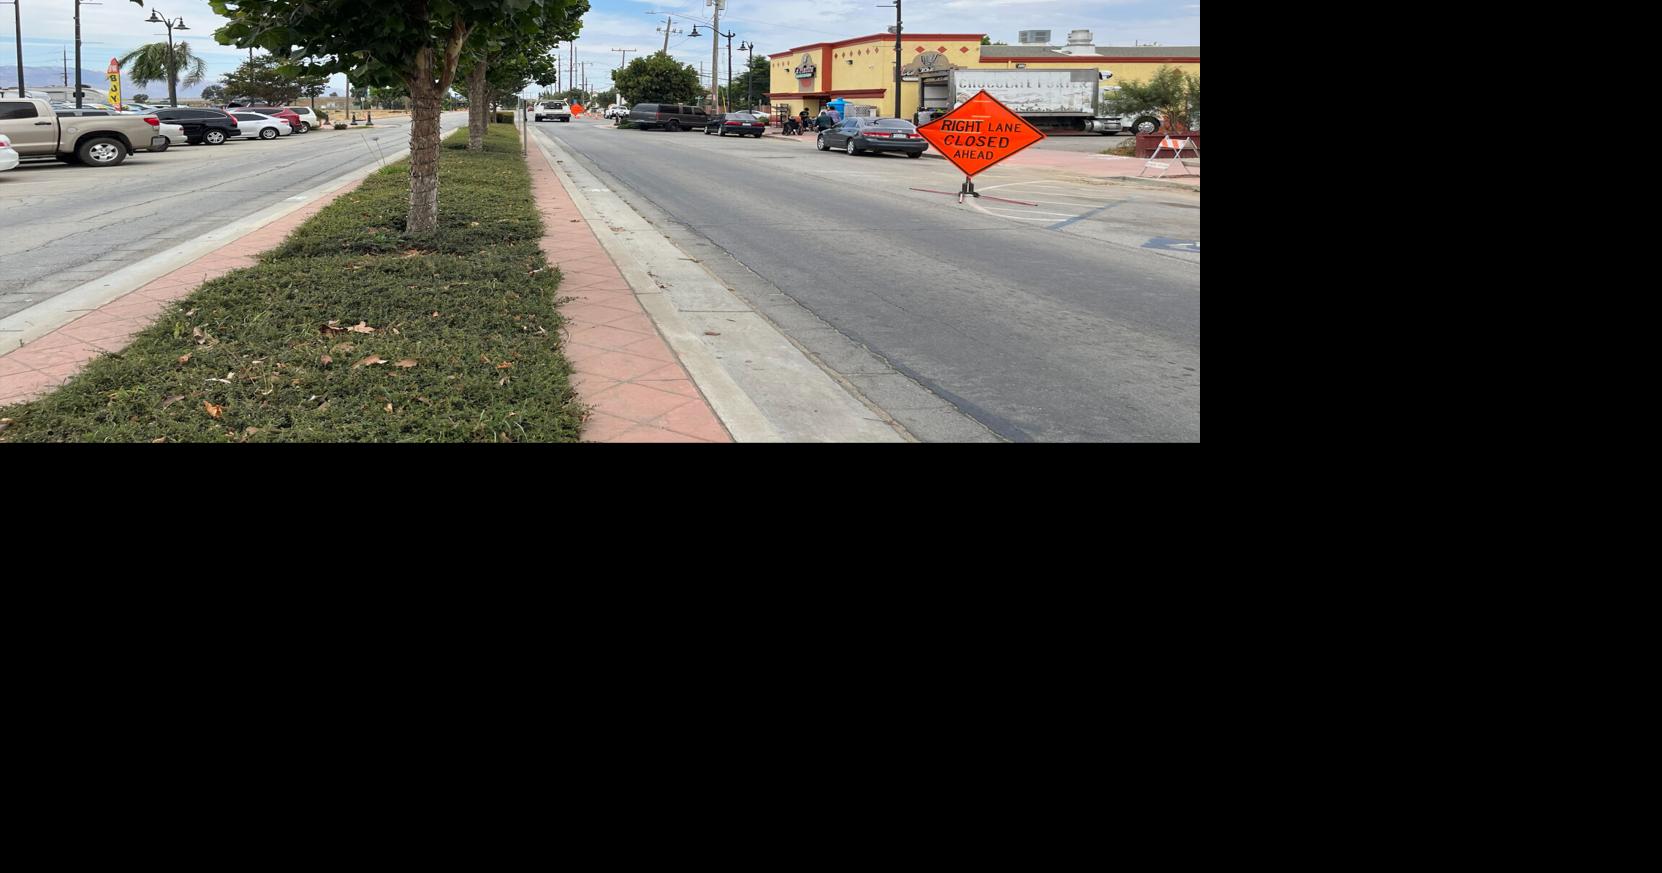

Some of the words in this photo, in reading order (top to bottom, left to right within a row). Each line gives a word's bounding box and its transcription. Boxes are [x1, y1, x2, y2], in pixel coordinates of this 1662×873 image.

[110, 74, 118, 103] BUY
[941, 119, 983, 132] RIGHT
[988, 122, 1022, 133] LANE
[943, 134, 1009, 149] CLOSED
[953, 149, 994, 160] AHEAD
